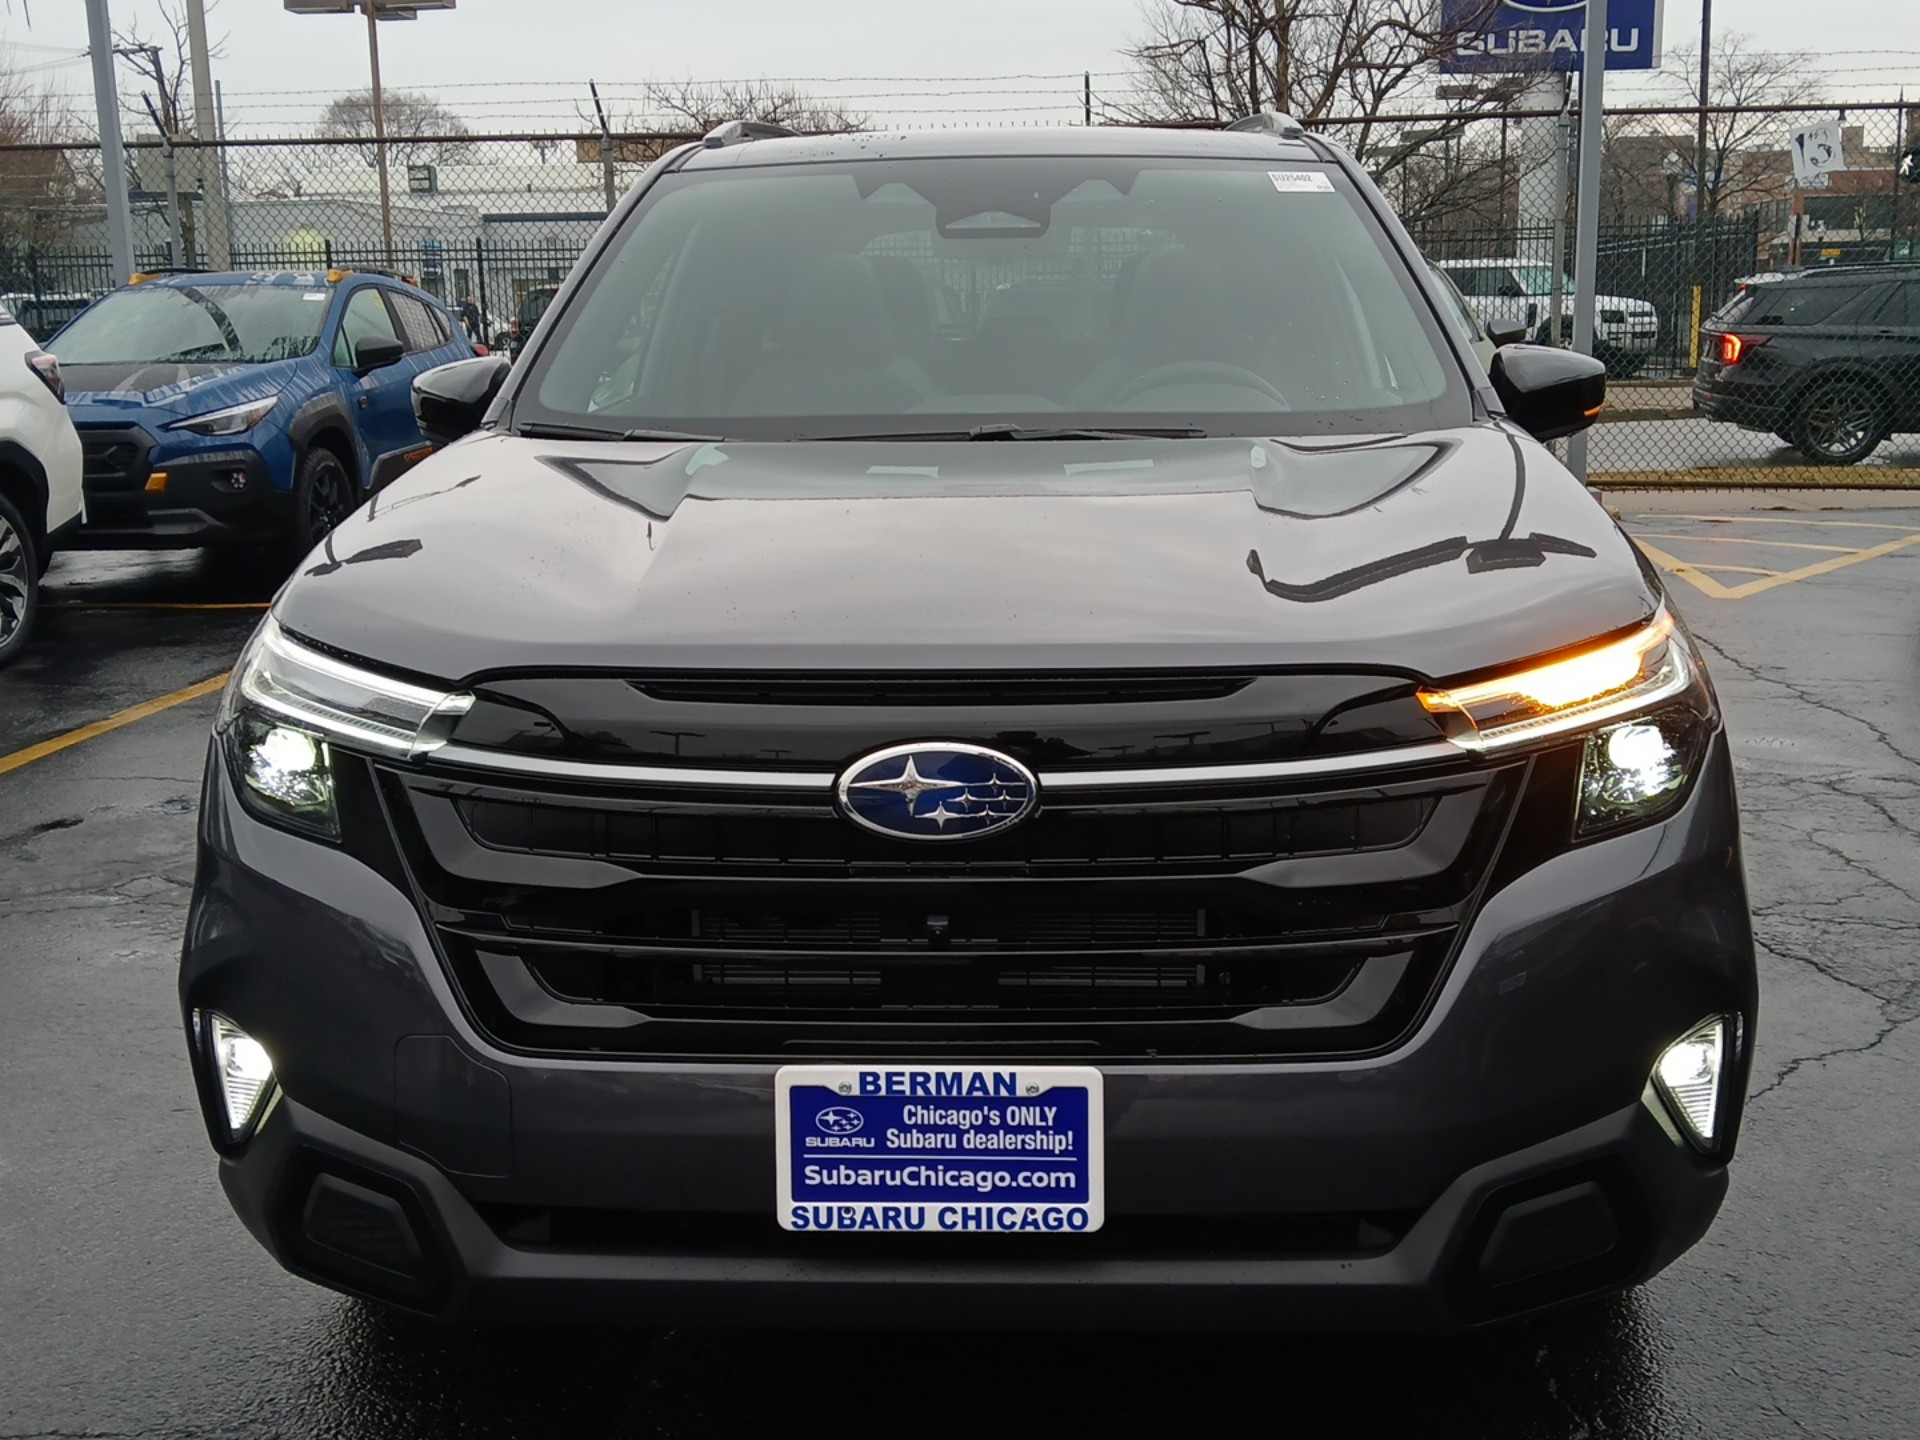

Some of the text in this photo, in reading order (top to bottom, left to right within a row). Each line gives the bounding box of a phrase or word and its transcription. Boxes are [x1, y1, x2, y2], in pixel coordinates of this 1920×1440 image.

[1456, 28, 1639, 55] SUBAU
[858, 1071, 1017, 1096] BERMAN
[903, 1105, 1057, 1129] Chicago's ONLY
[805, 1136, 875, 1148] SUBARU
[886, 1128, 1073, 1154] Subaru dealership!
[804, 1165, 1076, 1192] SubaruChicago.com
[791, 1206, 1089, 1231] SUBARU CHICAGO
